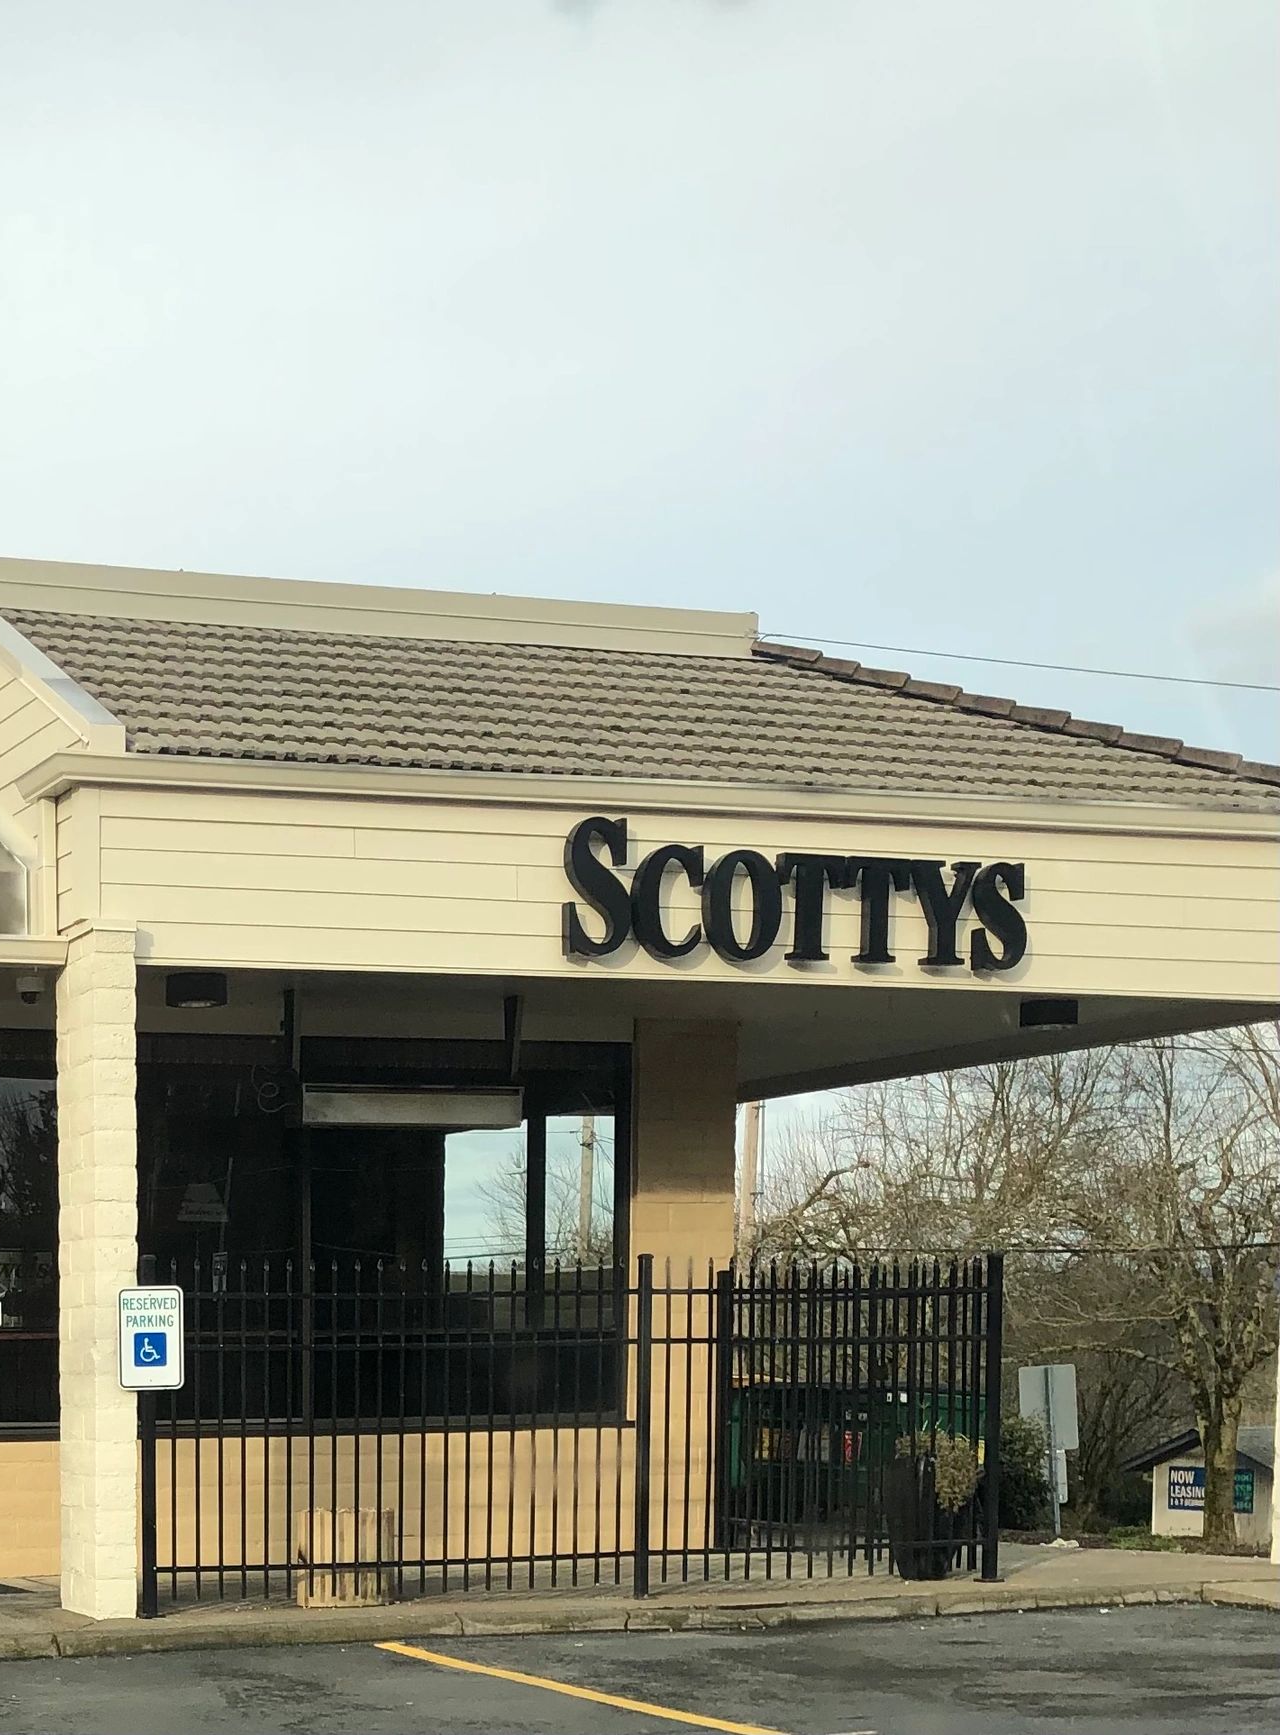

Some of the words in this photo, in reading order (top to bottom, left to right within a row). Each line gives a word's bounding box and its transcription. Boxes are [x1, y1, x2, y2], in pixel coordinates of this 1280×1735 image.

[562, 816, 1027, 972] SCOTTYS
[122, 1297, 177, 1311] RESERVED
[126, 1315, 174, 1328] PARKING
[1170, 1470, 1195, 1484] NOW
